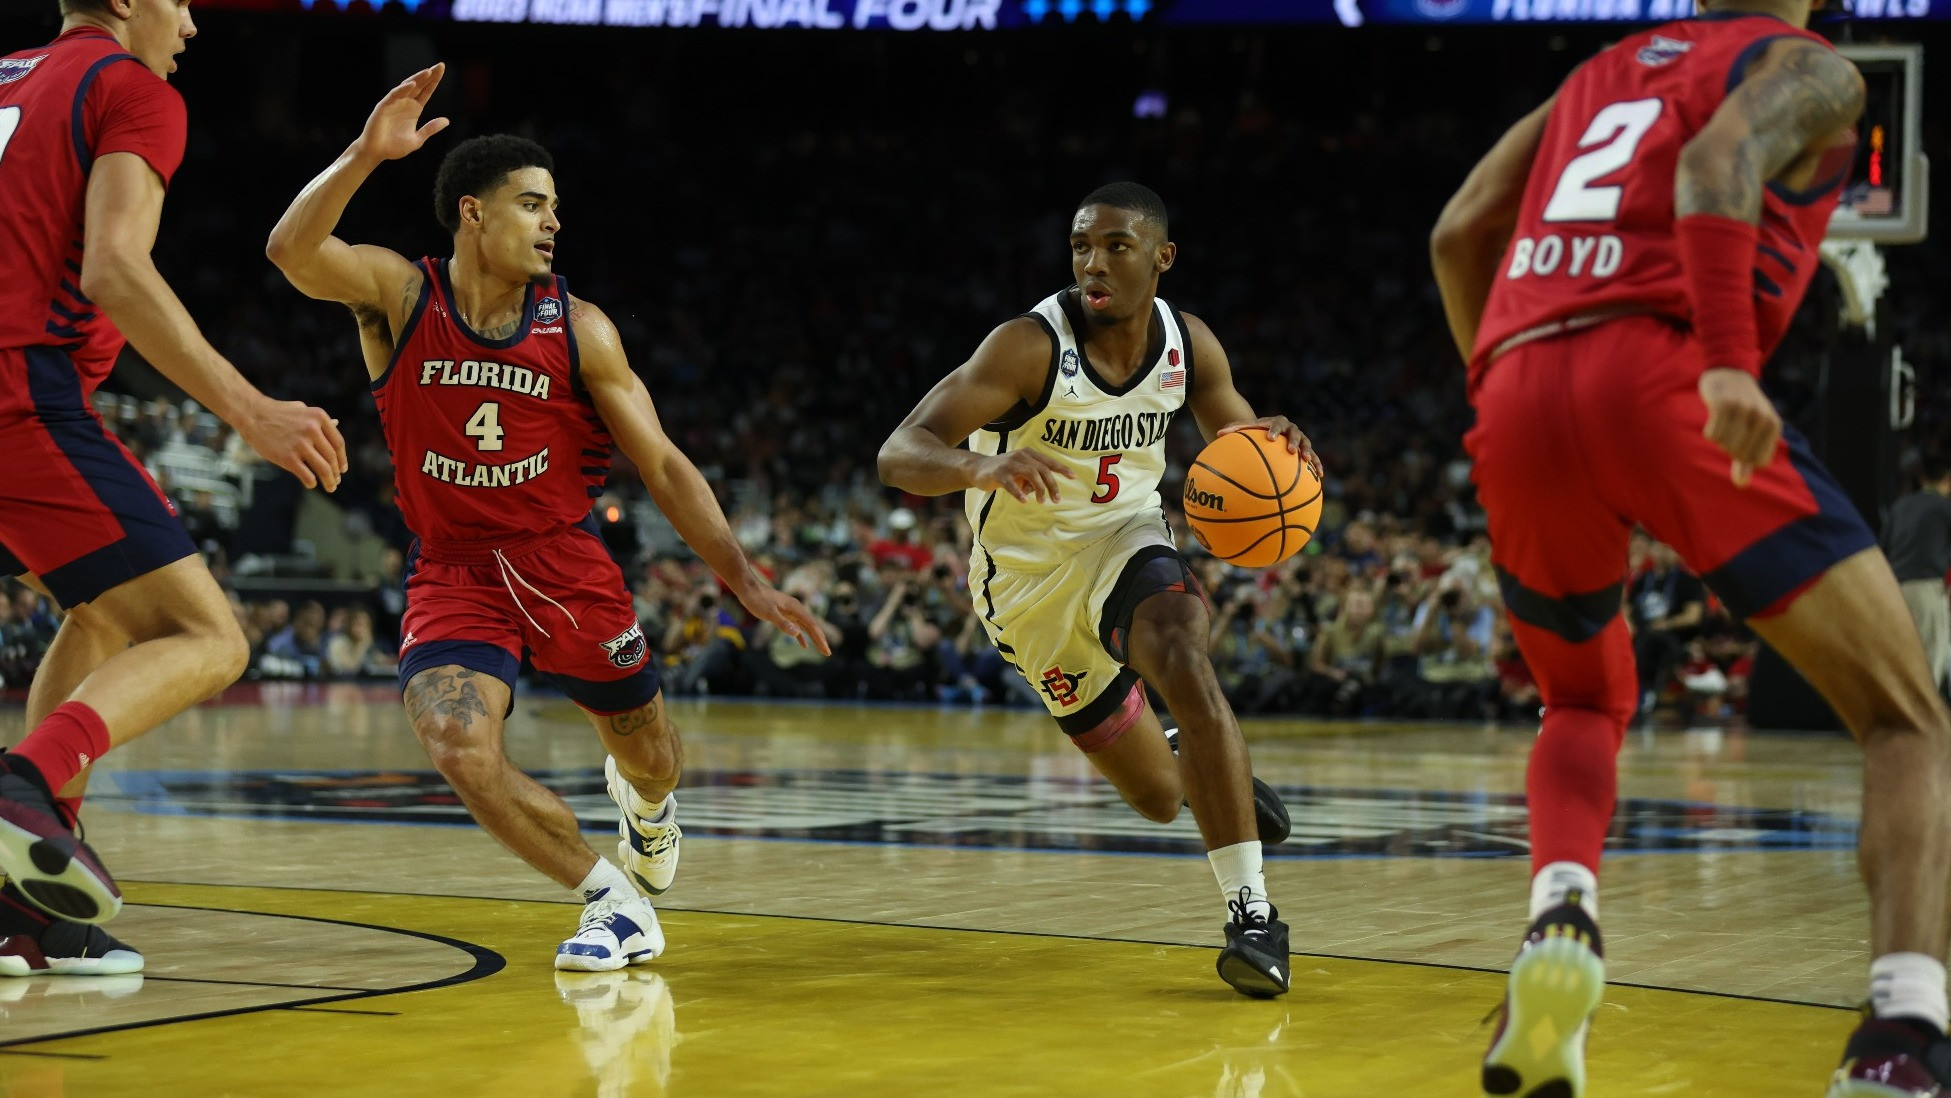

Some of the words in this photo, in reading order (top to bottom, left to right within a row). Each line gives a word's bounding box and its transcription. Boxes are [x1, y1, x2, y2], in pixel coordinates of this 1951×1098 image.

[852, 0, 999, 31] FOUR
[1542, 98, 1663, 221] 2
[1507, 234, 1624, 280] BOYD
[538, 302, 557, 312] FINAL
[540, 308, 559, 317] FOUR
[419, 360, 551, 401] FLORIDA
[464, 402, 505, 451] 4
[1041, 418, 1082, 450] SAN
[1080, 413, 1133, 452] DIEGO
[421, 447, 550, 488] ATLANTIC
[1090, 453, 1123, 504] 5
[607, 623, 643, 658] FAU
